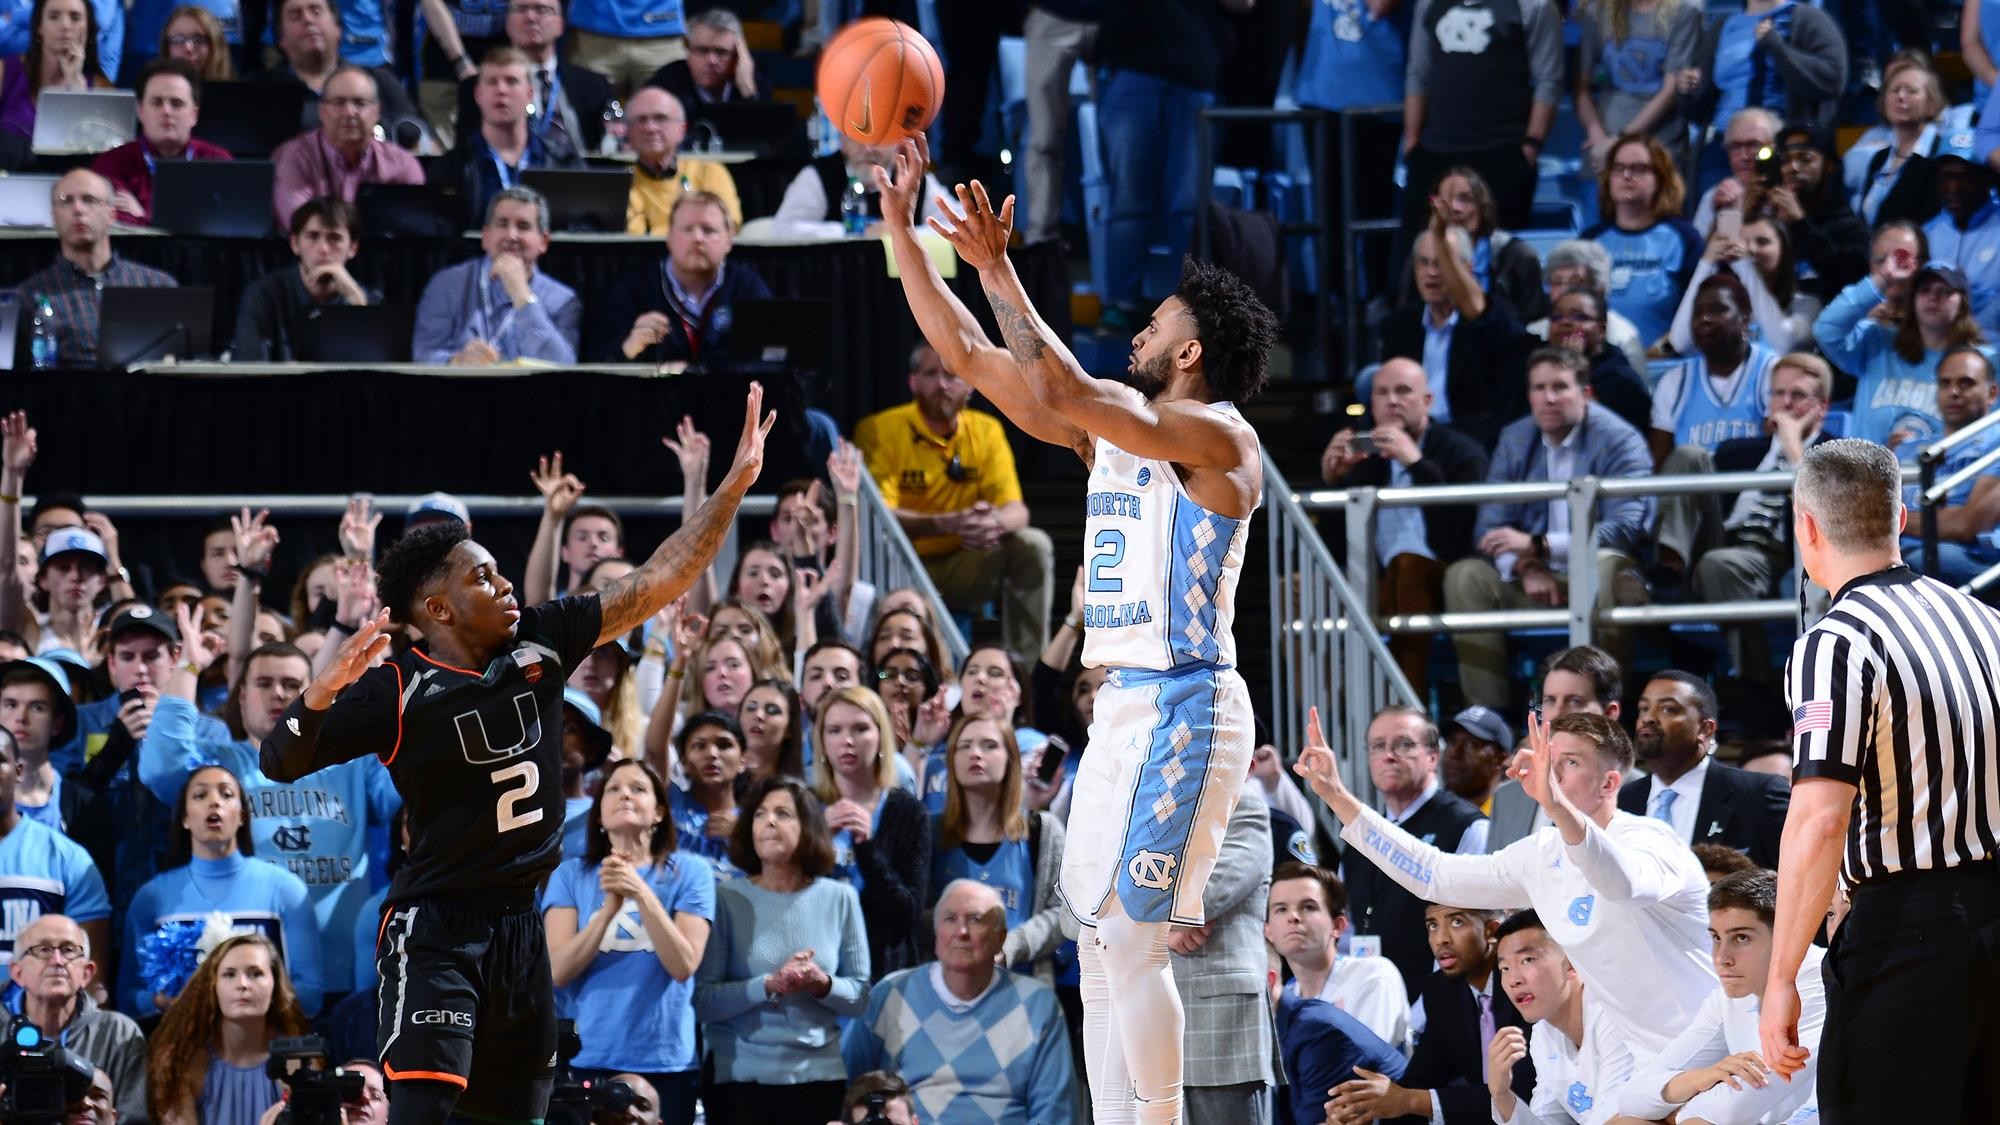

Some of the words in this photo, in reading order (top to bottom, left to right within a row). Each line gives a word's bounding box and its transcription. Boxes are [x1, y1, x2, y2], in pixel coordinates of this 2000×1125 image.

[1088, 529, 1126, 593] 2
[1084, 601, 1152, 628] ROLINA
[454, 691, 541, 764] U
[248, 790, 350, 825] AROLINA
[491, 761, 543, 832] 2
[1366, 828, 1392, 857] TAR
[1390, 850, 1432, 884] HEELS
